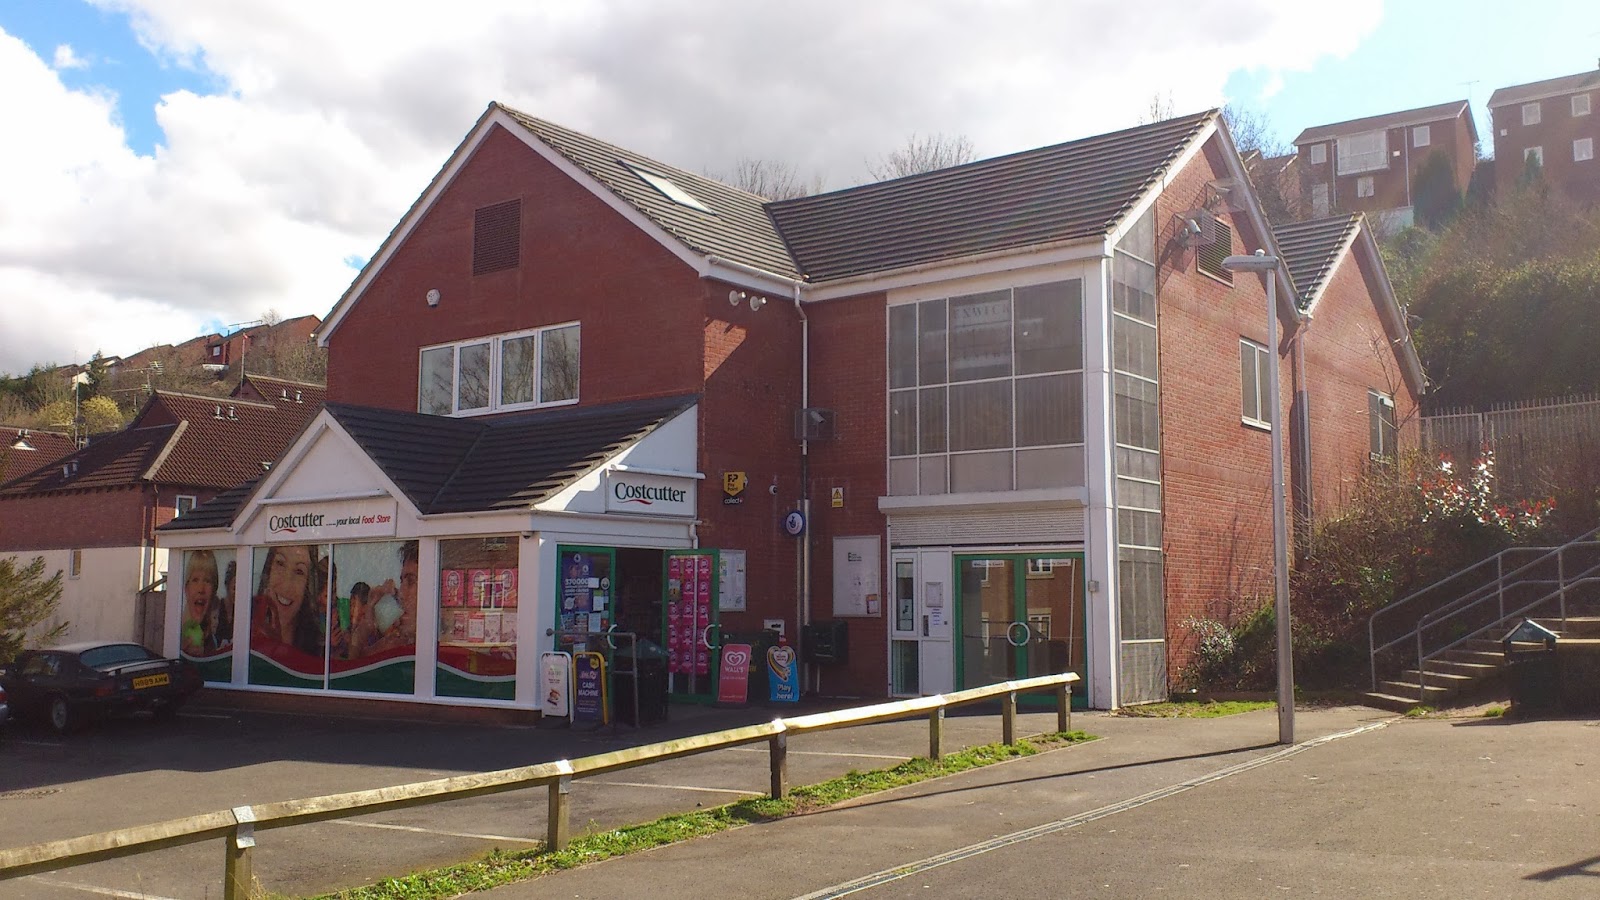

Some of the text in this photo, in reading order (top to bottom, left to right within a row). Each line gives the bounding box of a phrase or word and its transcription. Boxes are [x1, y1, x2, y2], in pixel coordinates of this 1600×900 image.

[615, 482, 686, 503] Costcutter
[269, 512, 325, 531] Costcutter
[348, 515, 360, 525] local
[361, 515, 375, 525] Food
[376, 514, 391, 524] Store
[578, 689, 599, 697] MACHINE
[777, 684, 792, 692] Play
